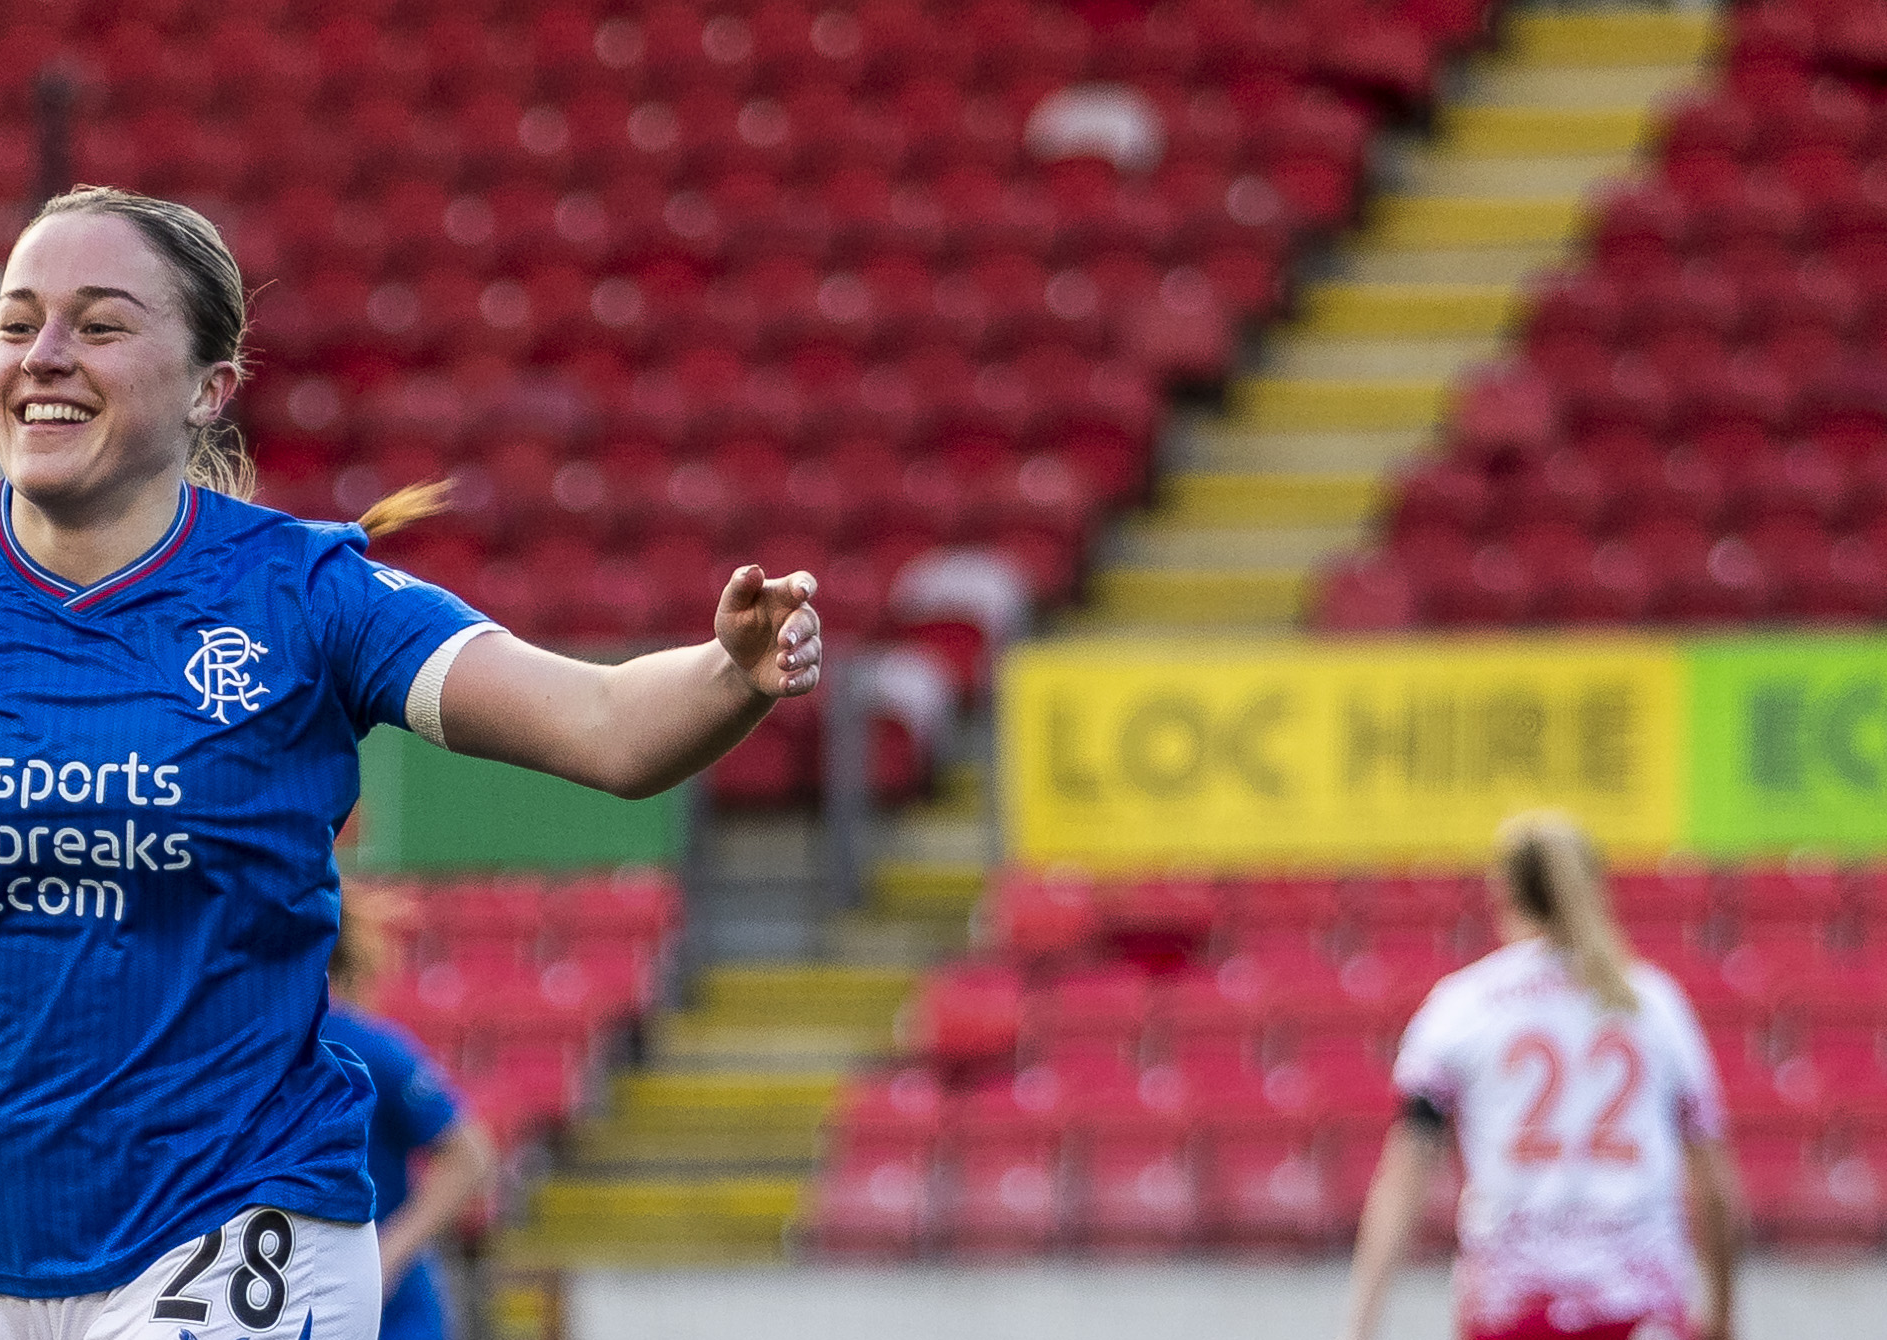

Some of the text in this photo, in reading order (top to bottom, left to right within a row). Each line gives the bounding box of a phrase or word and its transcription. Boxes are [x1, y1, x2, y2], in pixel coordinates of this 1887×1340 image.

[1342, 680, 1636, 794] HIRE
[1498, 1026, 1646, 1166] 22
[149, 1208, 296, 1333] 28
